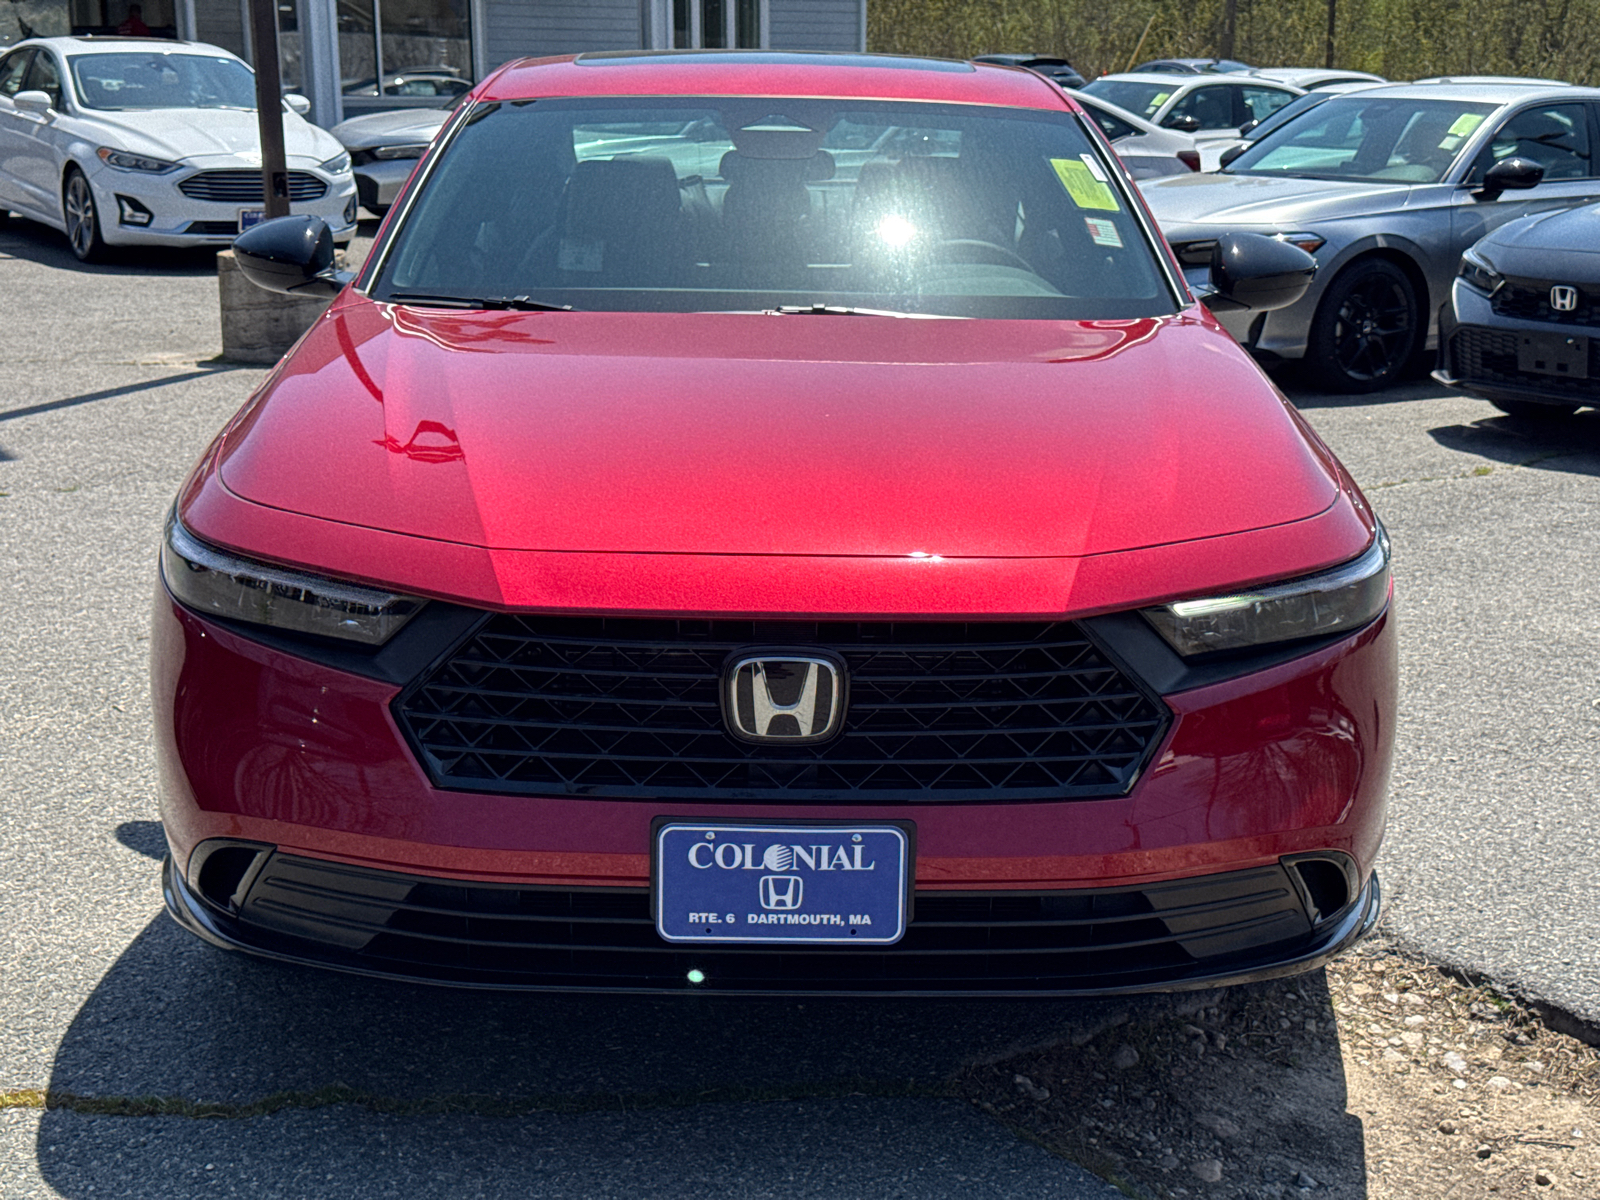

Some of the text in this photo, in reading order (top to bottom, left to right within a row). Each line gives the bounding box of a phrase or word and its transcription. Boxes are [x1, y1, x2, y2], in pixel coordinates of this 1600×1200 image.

[688, 842, 875, 871] COLONIAL
[688, 912, 872, 926] RTE. 6 DARTMOUTH, MA
